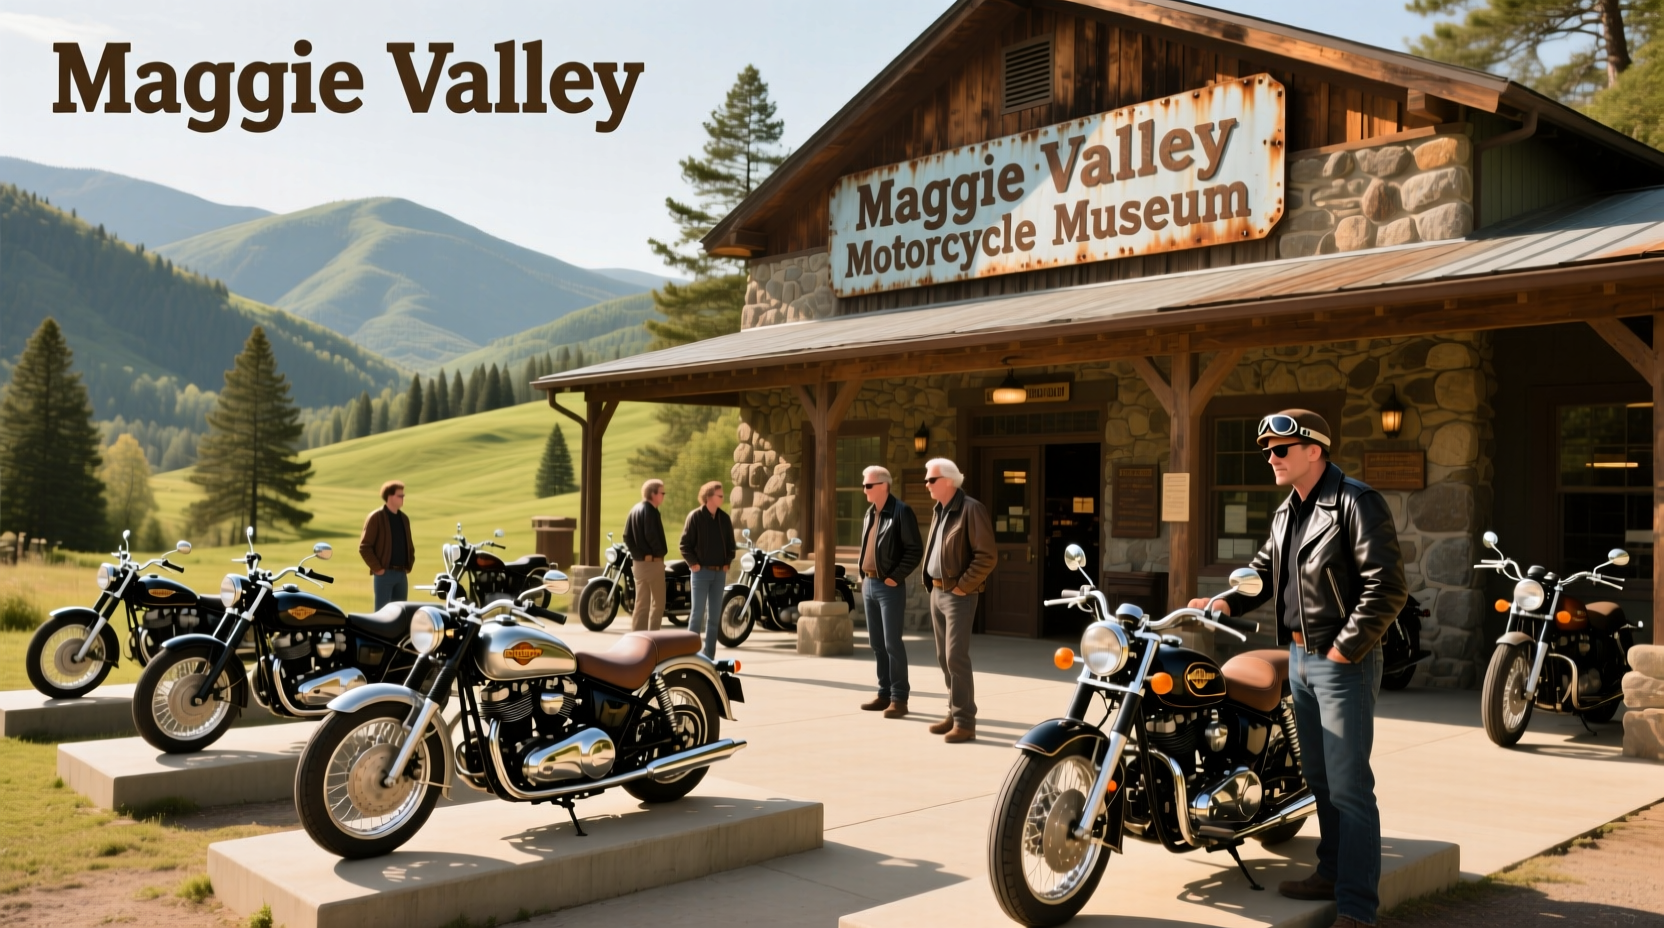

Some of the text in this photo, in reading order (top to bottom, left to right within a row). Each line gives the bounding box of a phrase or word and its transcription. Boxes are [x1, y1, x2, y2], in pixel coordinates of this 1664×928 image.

[856, 117, 1238, 231] Maggie Valley
[845, 180, 1252, 278] Motorcycle Museum
